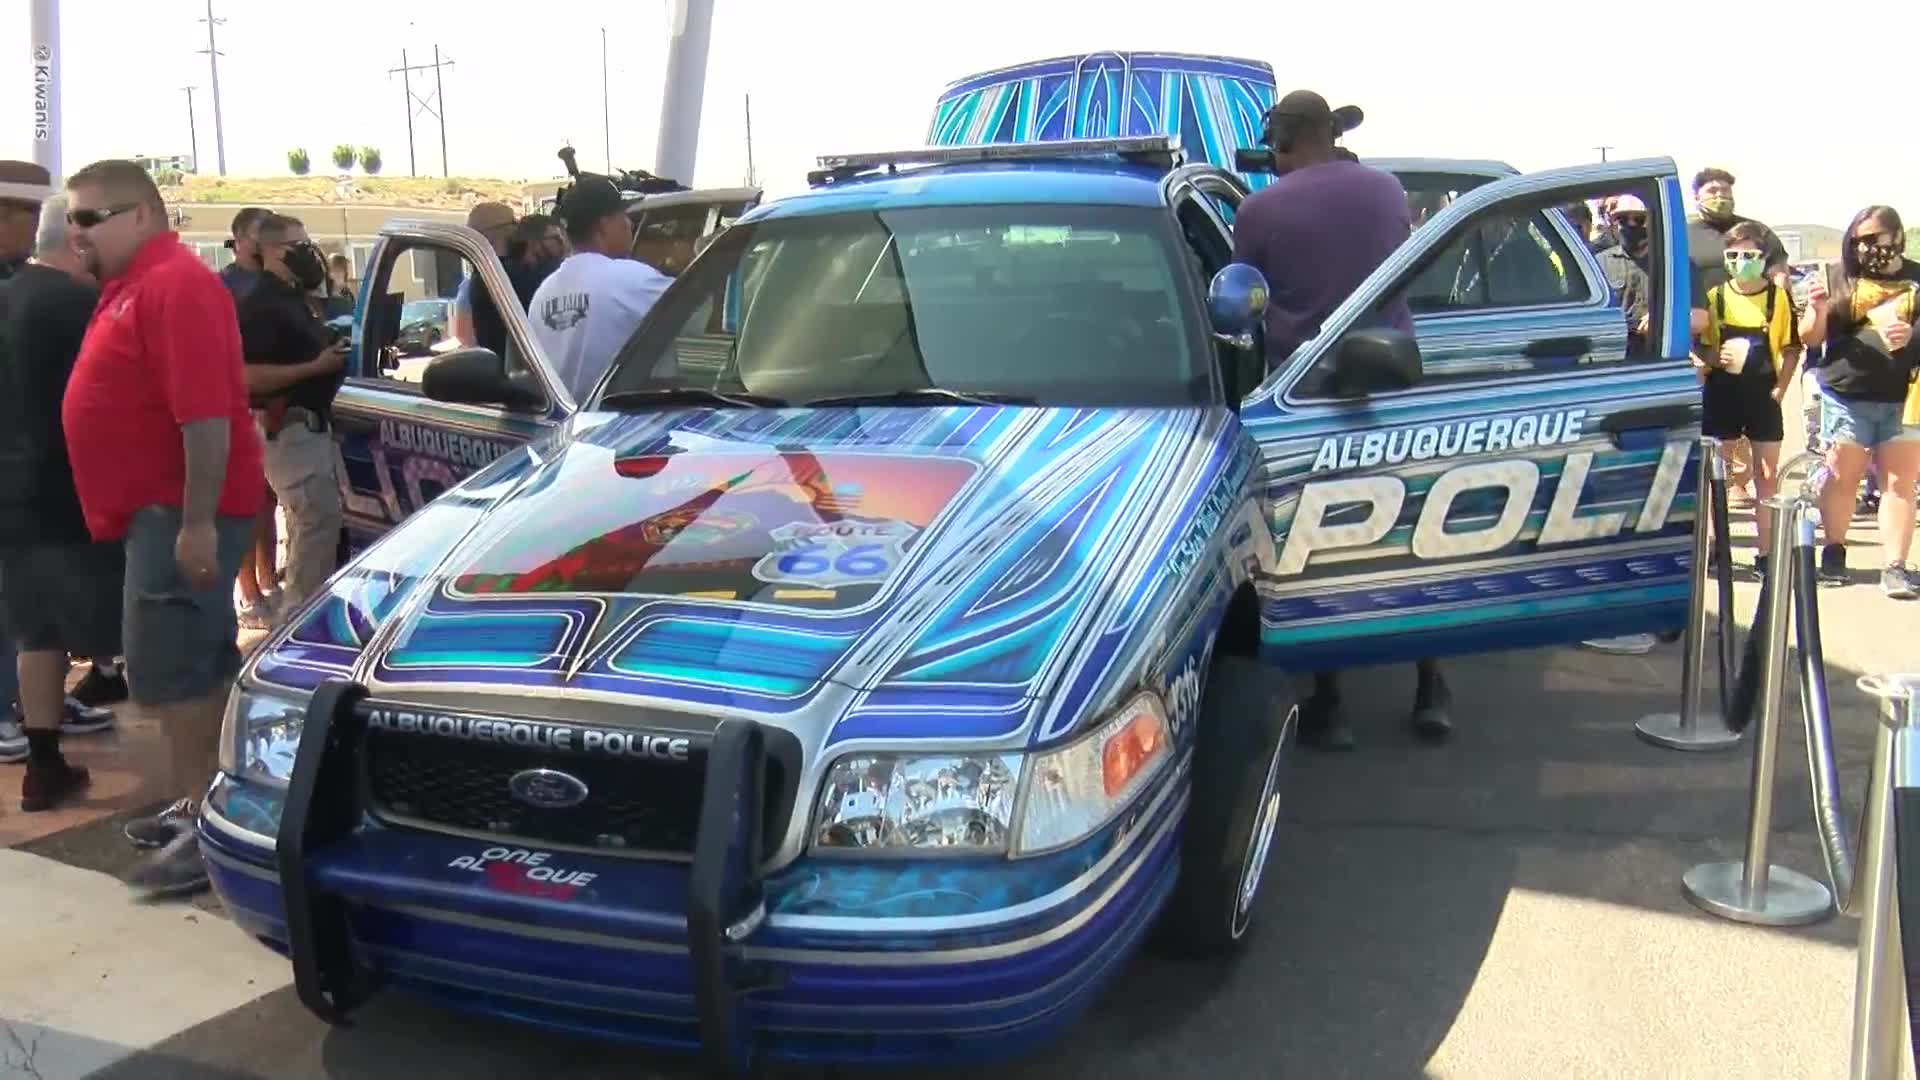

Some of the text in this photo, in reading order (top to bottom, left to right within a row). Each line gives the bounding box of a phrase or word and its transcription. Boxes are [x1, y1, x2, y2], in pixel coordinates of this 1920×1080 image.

[34, 65, 51, 139] Kiwanis
[1312, 409, 1587, 472] ALBUQUERQUE
[1279, 438, 1692, 575] POLI
[795, 523, 890, 537] ROUTE
[777, 543, 888, 576] 66
[368, 709, 690, 761] ALBUQUERQUE POLICE
[481, 847, 552, 866] ONE
[526, 866, 599, 887] QUE
